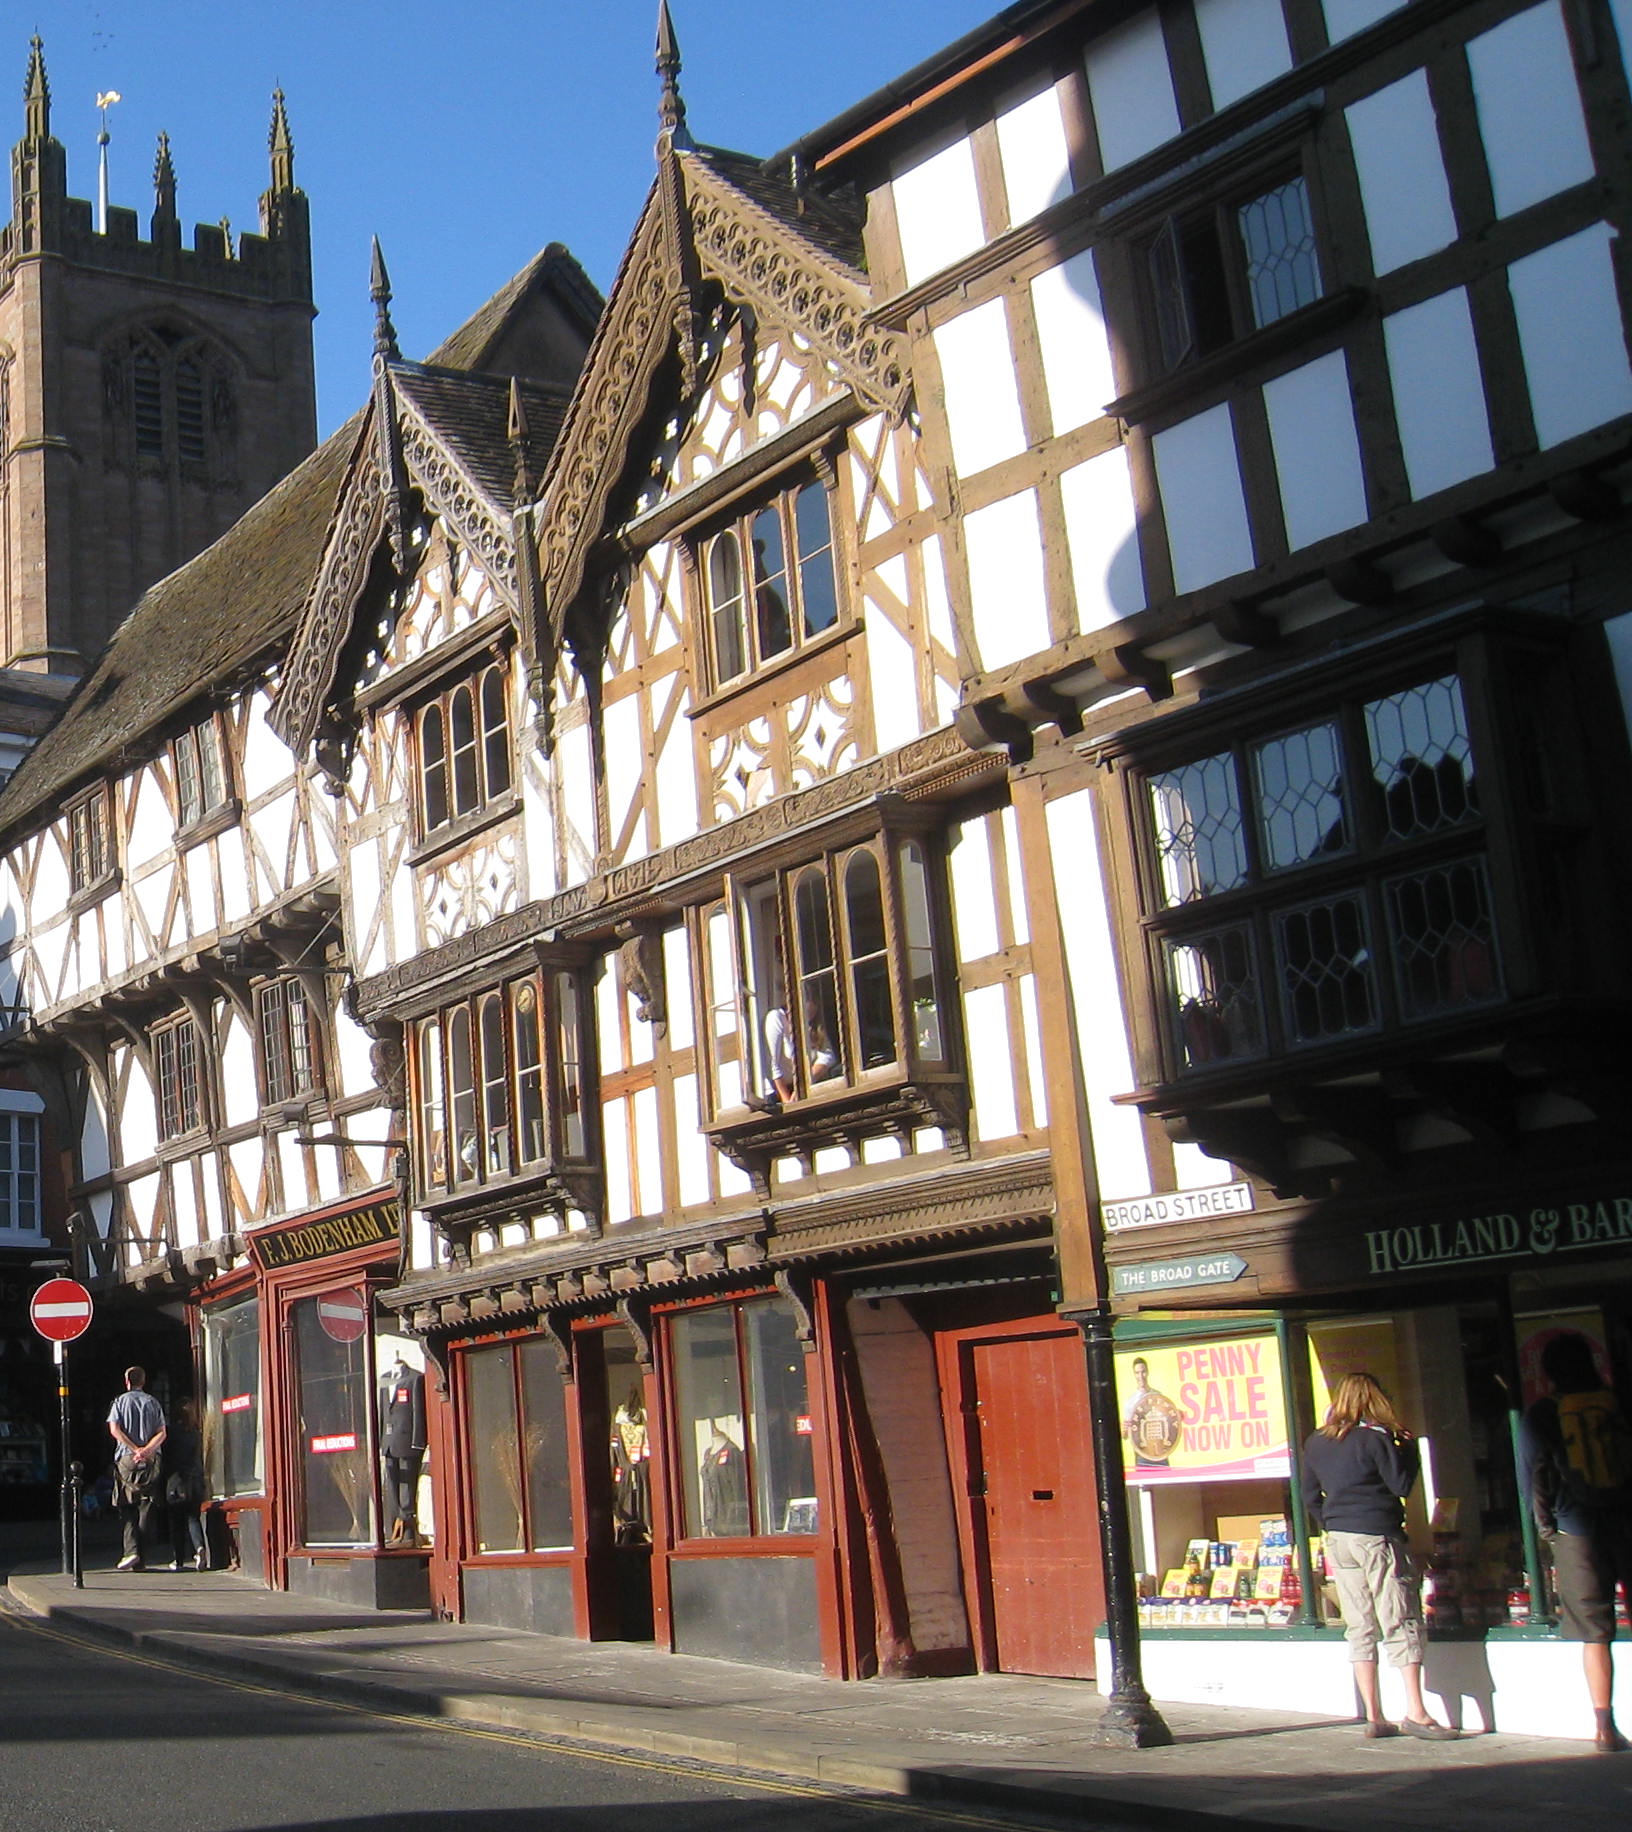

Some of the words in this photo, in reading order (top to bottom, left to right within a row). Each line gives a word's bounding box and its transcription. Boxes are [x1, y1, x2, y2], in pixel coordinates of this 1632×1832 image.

[1106, 1200, 1168, 1228] BROAD
[1173, 1188, 1245, 1217] STREET
[287, 1209, 384, 1258] BODENHAM
[1365, 1213, 1521, 1274] HOLLAND
[1529, 1208, 1560, 1255] &
[1121, 1271, 1146, 1286] THE
[1151, 1267, 1192, 1283] BROAD
[1197, 1261, 1231, 1277] GATE
[1176, 1342, 1262, 1382] PENNY
[1180, 1376, 1269, 1426] SALE
[1183, 1423, 1232, 1453] NOW
[1241, 1421, 1269, 1448] ON
